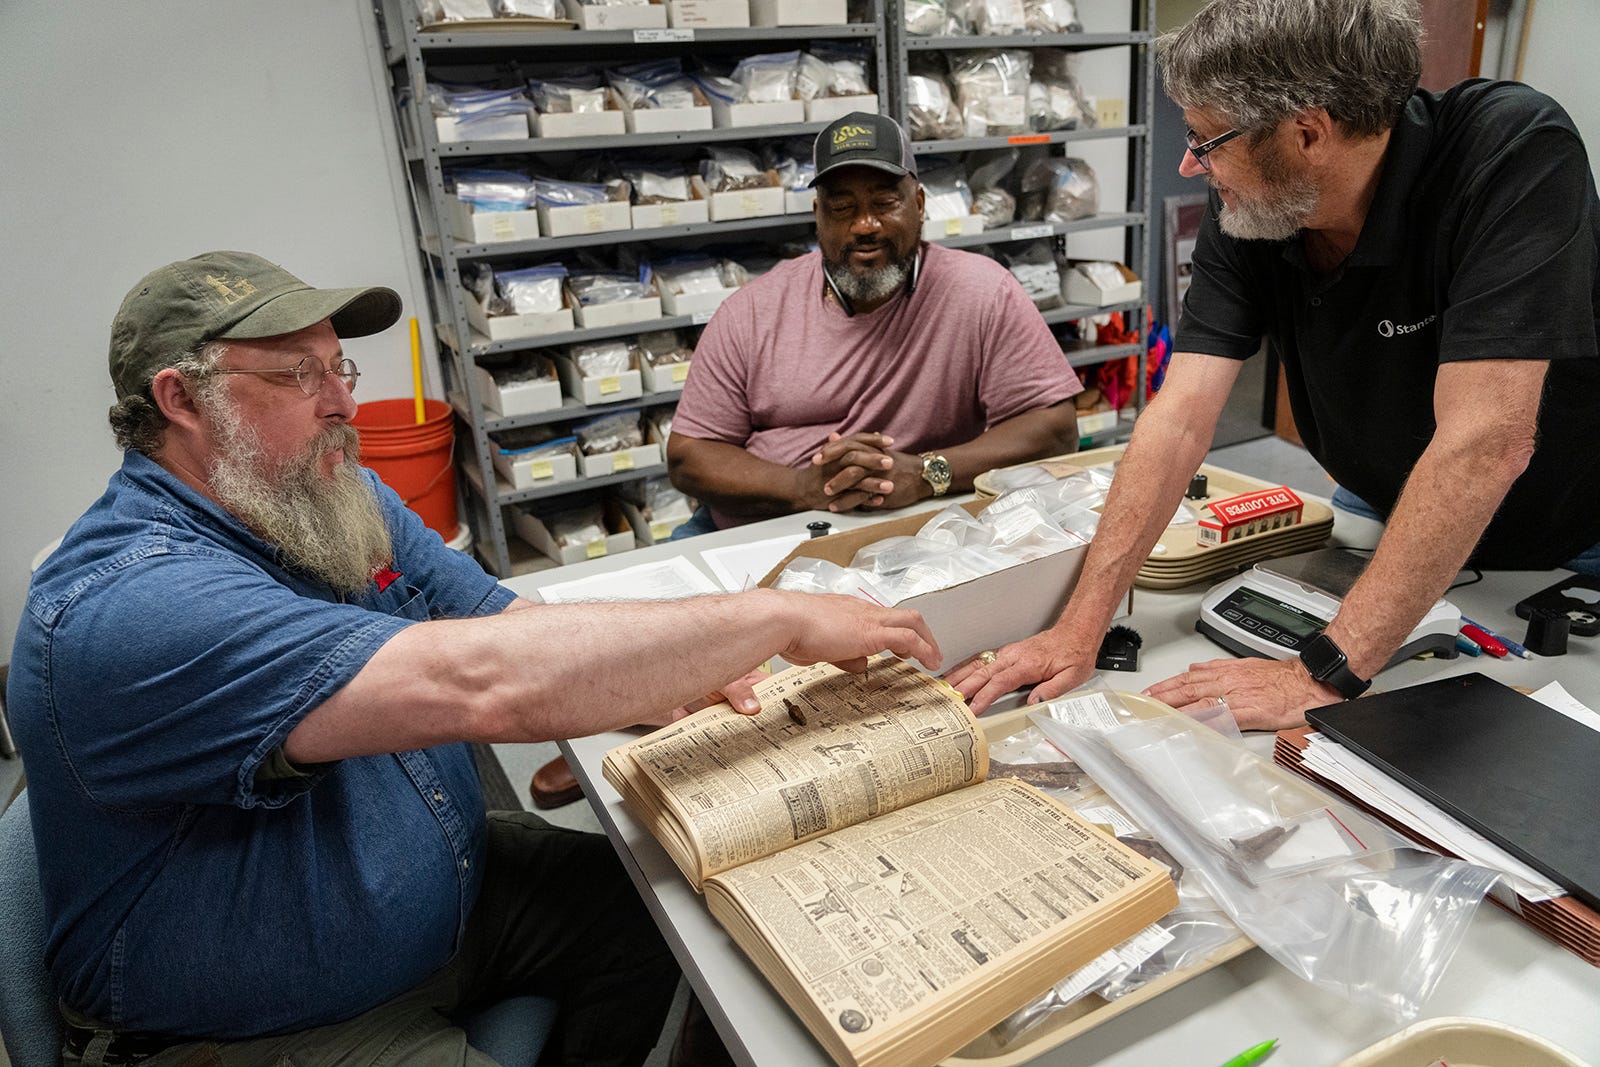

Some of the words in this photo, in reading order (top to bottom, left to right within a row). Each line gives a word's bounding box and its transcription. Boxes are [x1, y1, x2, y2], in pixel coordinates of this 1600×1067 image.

[1225, 498, 1268, 516] LOUPES
[1266, 493, 1290, 506] EYE
[1045, 808, 1063, 822] STEEL
[1064, 822, 1091, 842] SQUARES
